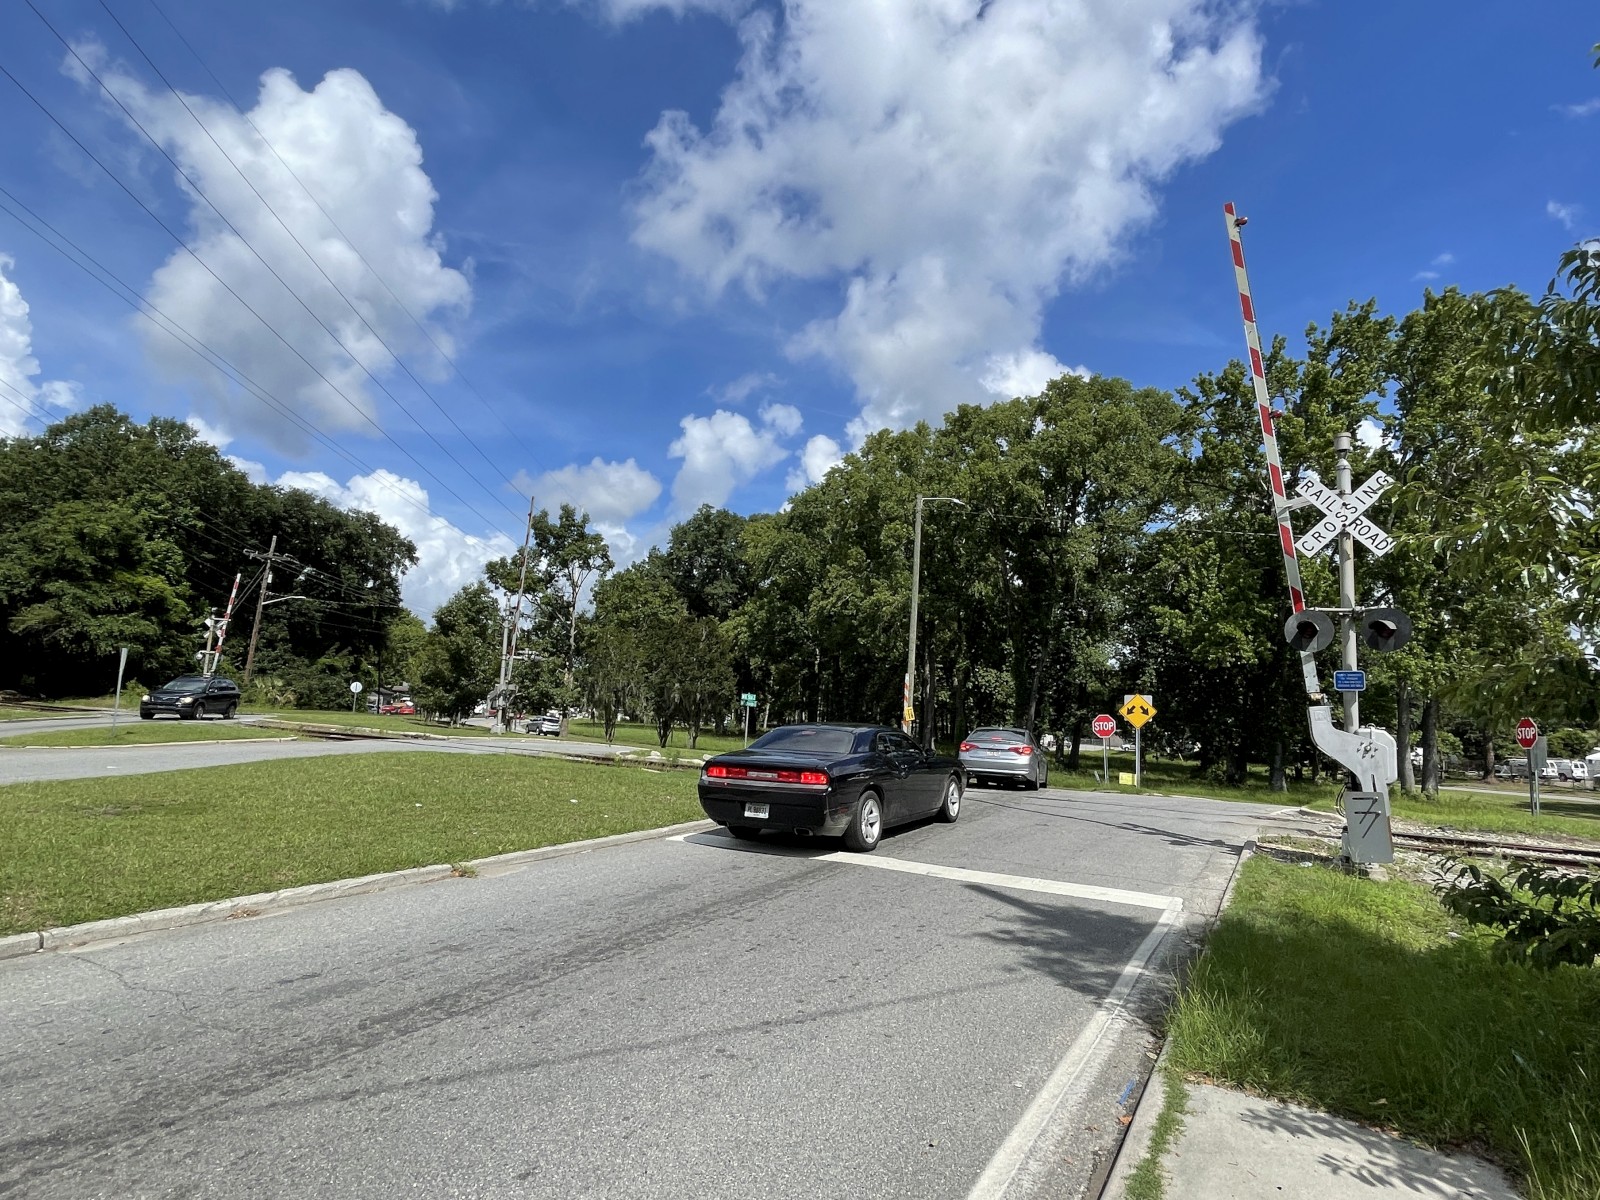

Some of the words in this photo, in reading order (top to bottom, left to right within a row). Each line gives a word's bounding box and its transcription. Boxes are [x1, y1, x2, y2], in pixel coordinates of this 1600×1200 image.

[1301, 475, 1389, 552] CROSSING
[1094, 722, 1113, 730] STOP
[1517, 727, 1536, 739] STOP
